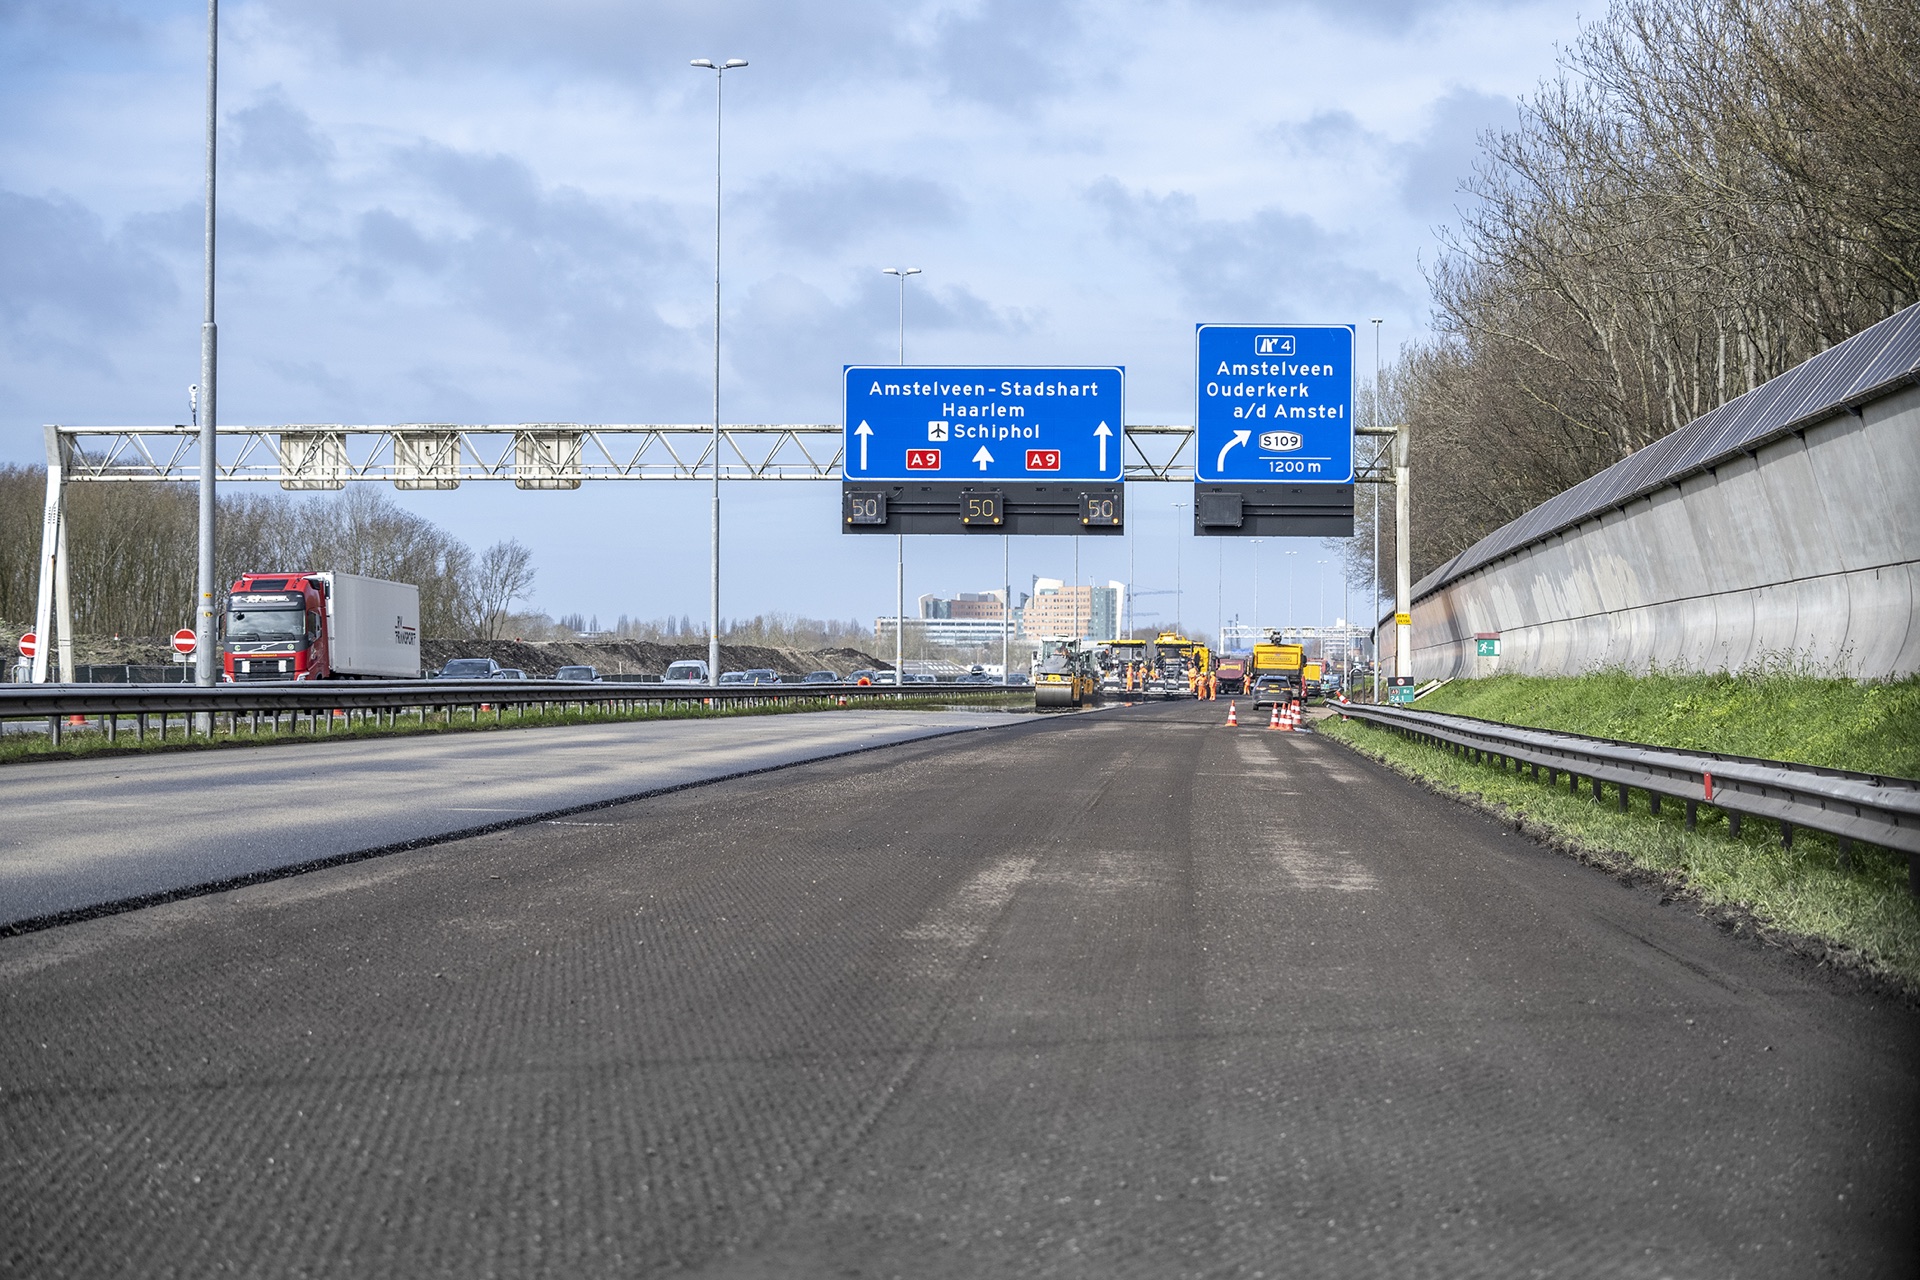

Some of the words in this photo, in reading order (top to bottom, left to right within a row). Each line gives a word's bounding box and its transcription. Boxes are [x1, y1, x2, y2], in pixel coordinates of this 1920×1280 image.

[1280, 340, 1291, 352] 4
[1216, 360, 1334, 376] Amstelveen
[869, 381, 1099, 397] Amstelveen-Stadshart
[1206, 382, 1309, 397] Ouderkerk
[942, 402, 1025, 417] Haarlem
[1233, 403, 1266, 419] a/d
[1273, 404, 1344, 419] Amstel
[954, 424, 1040, 441] Schiphol
[1263, 435, 1299, 447] S109
[911, 453, 937, 466] A9
[1030, 453, 1056, 467] A9
[1269, 461, 1305, 473] 1200
[1307, 462, 1322, 473] m
[852, 499, 877, 517] 50
[969, 499, 994, 517] 50
[1088, 499, 1113, 518] 50
